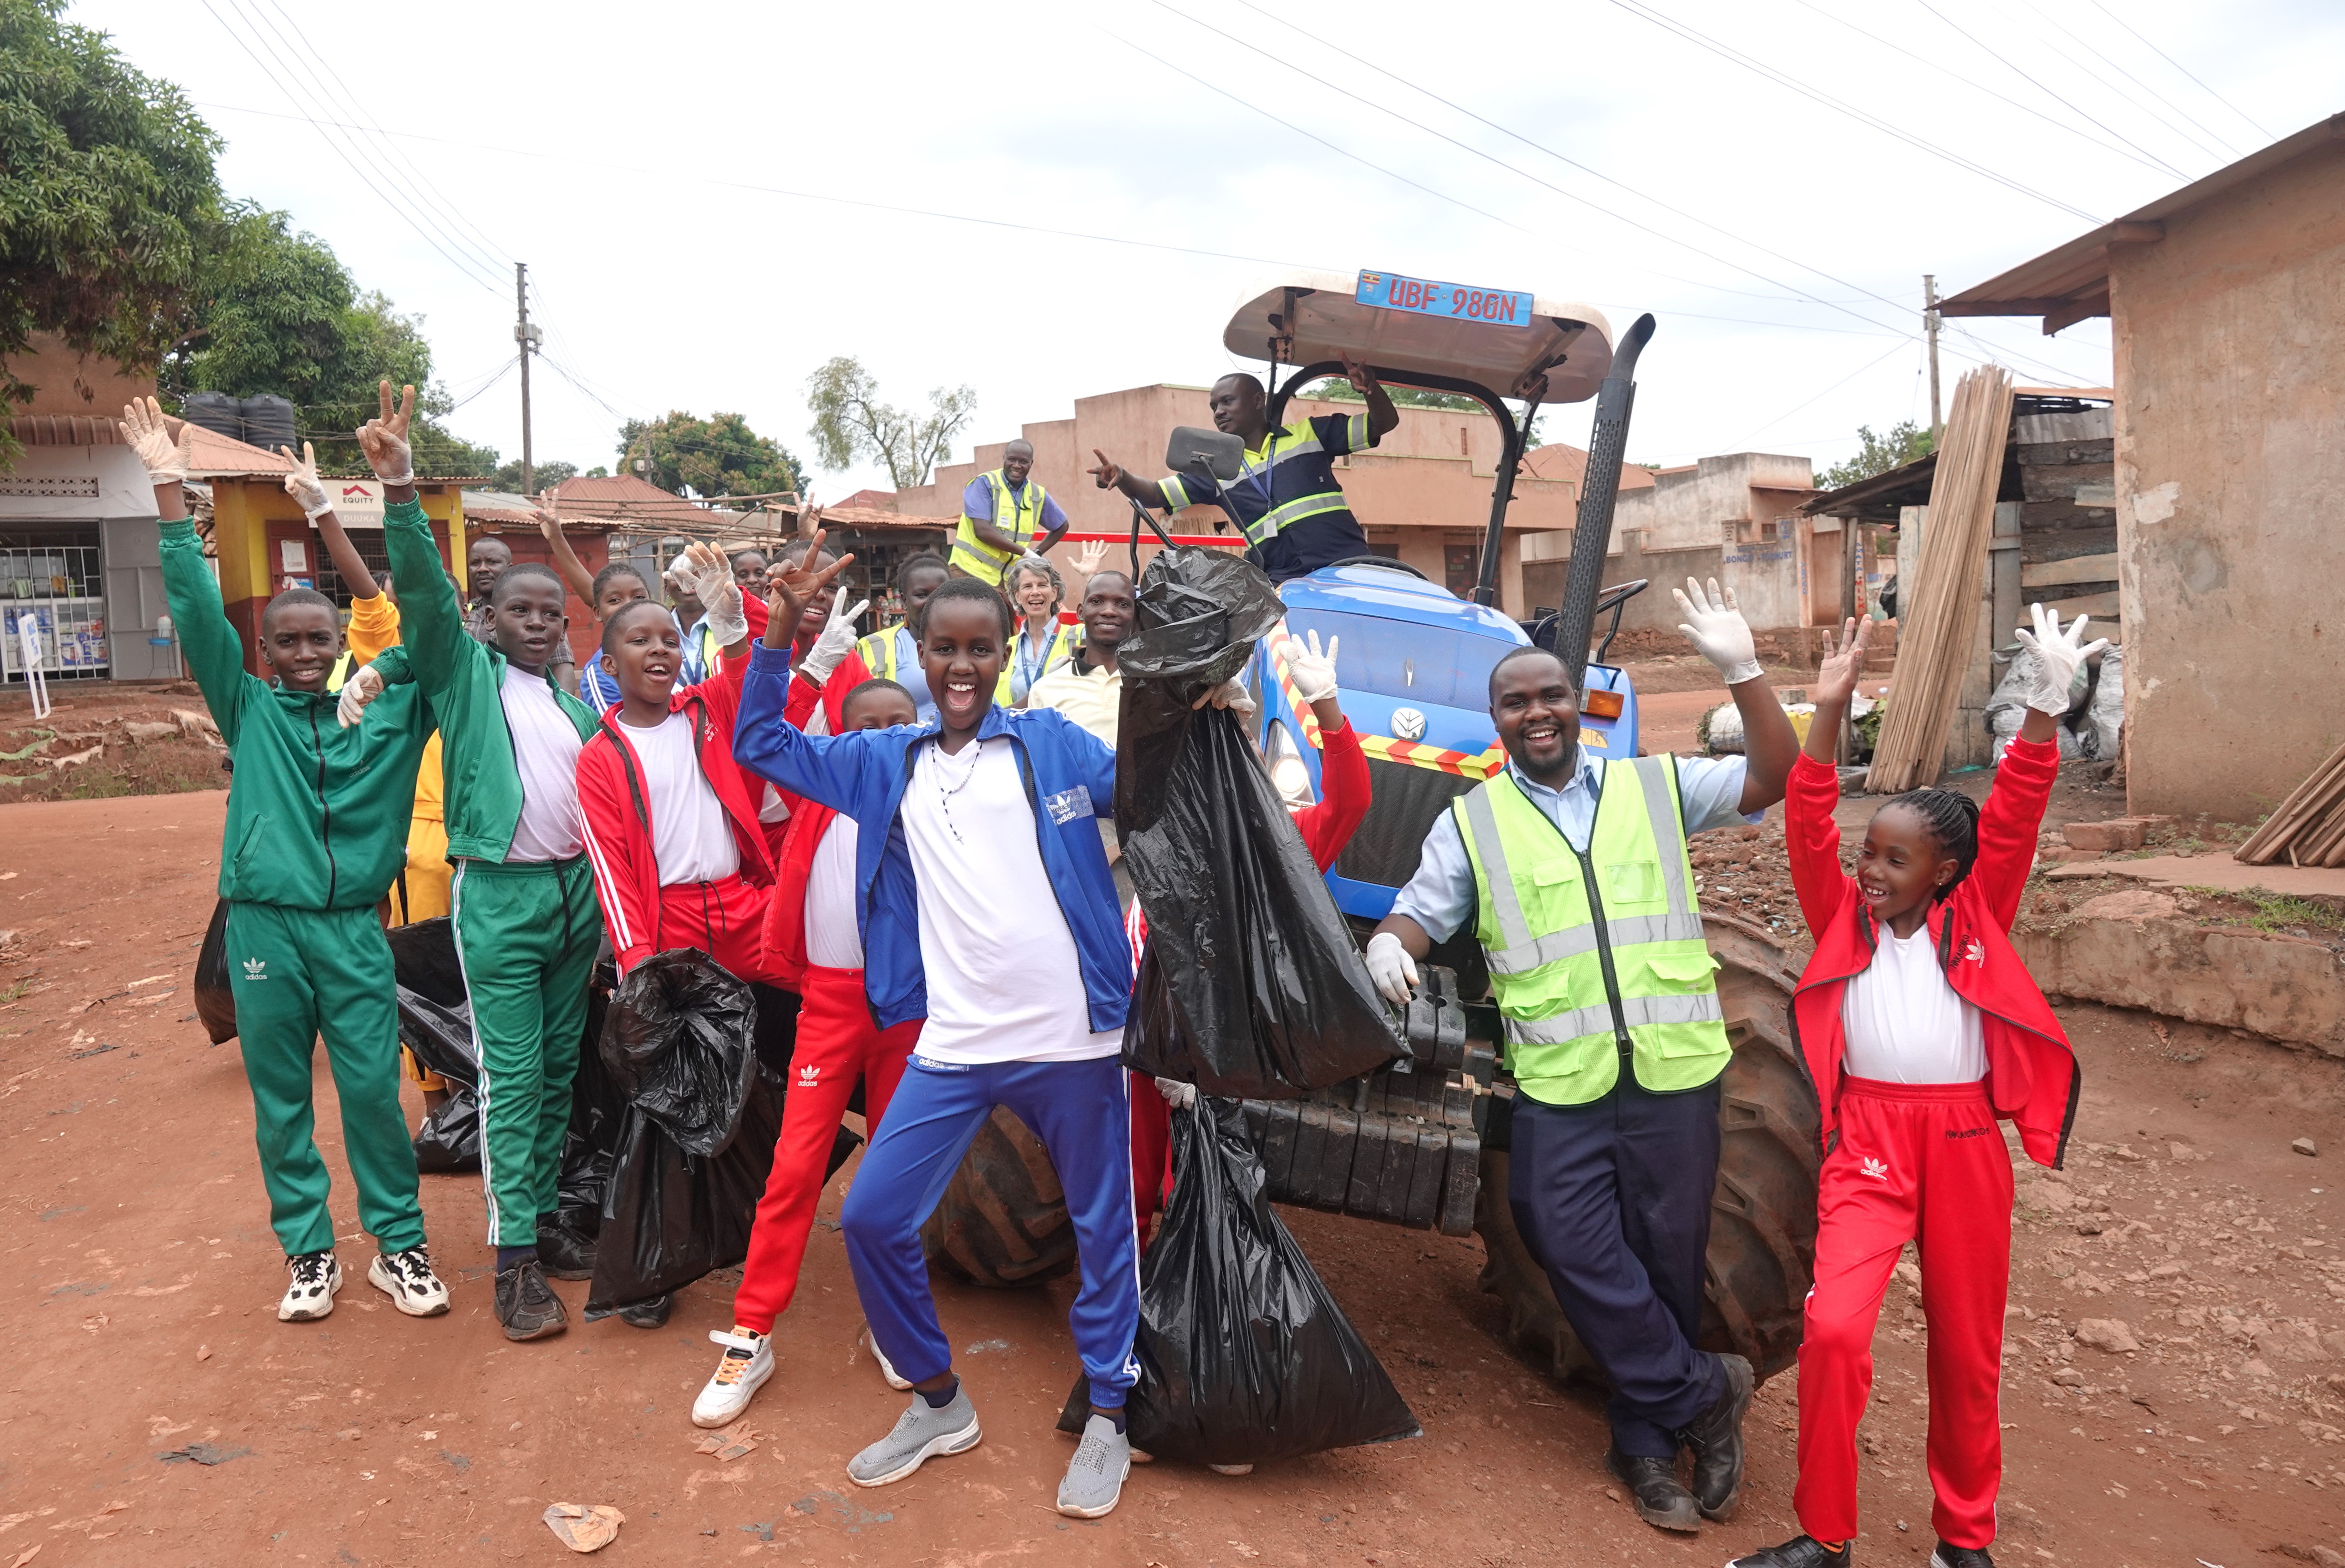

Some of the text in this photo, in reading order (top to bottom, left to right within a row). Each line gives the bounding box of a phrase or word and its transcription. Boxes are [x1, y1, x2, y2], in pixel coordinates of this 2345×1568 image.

[1388, 278, 1439, 309] UBF
[1726, 554, 1753, 563] BONGO
[1855, 543, 1864, 571] AMATA
[1855, 580, 1864, 608] MILK
[1056, 811, 1077, 825] adidas
[919, 1058, 945, 1068] adidas
[1860, 1168, 1888, 1181] adidas
